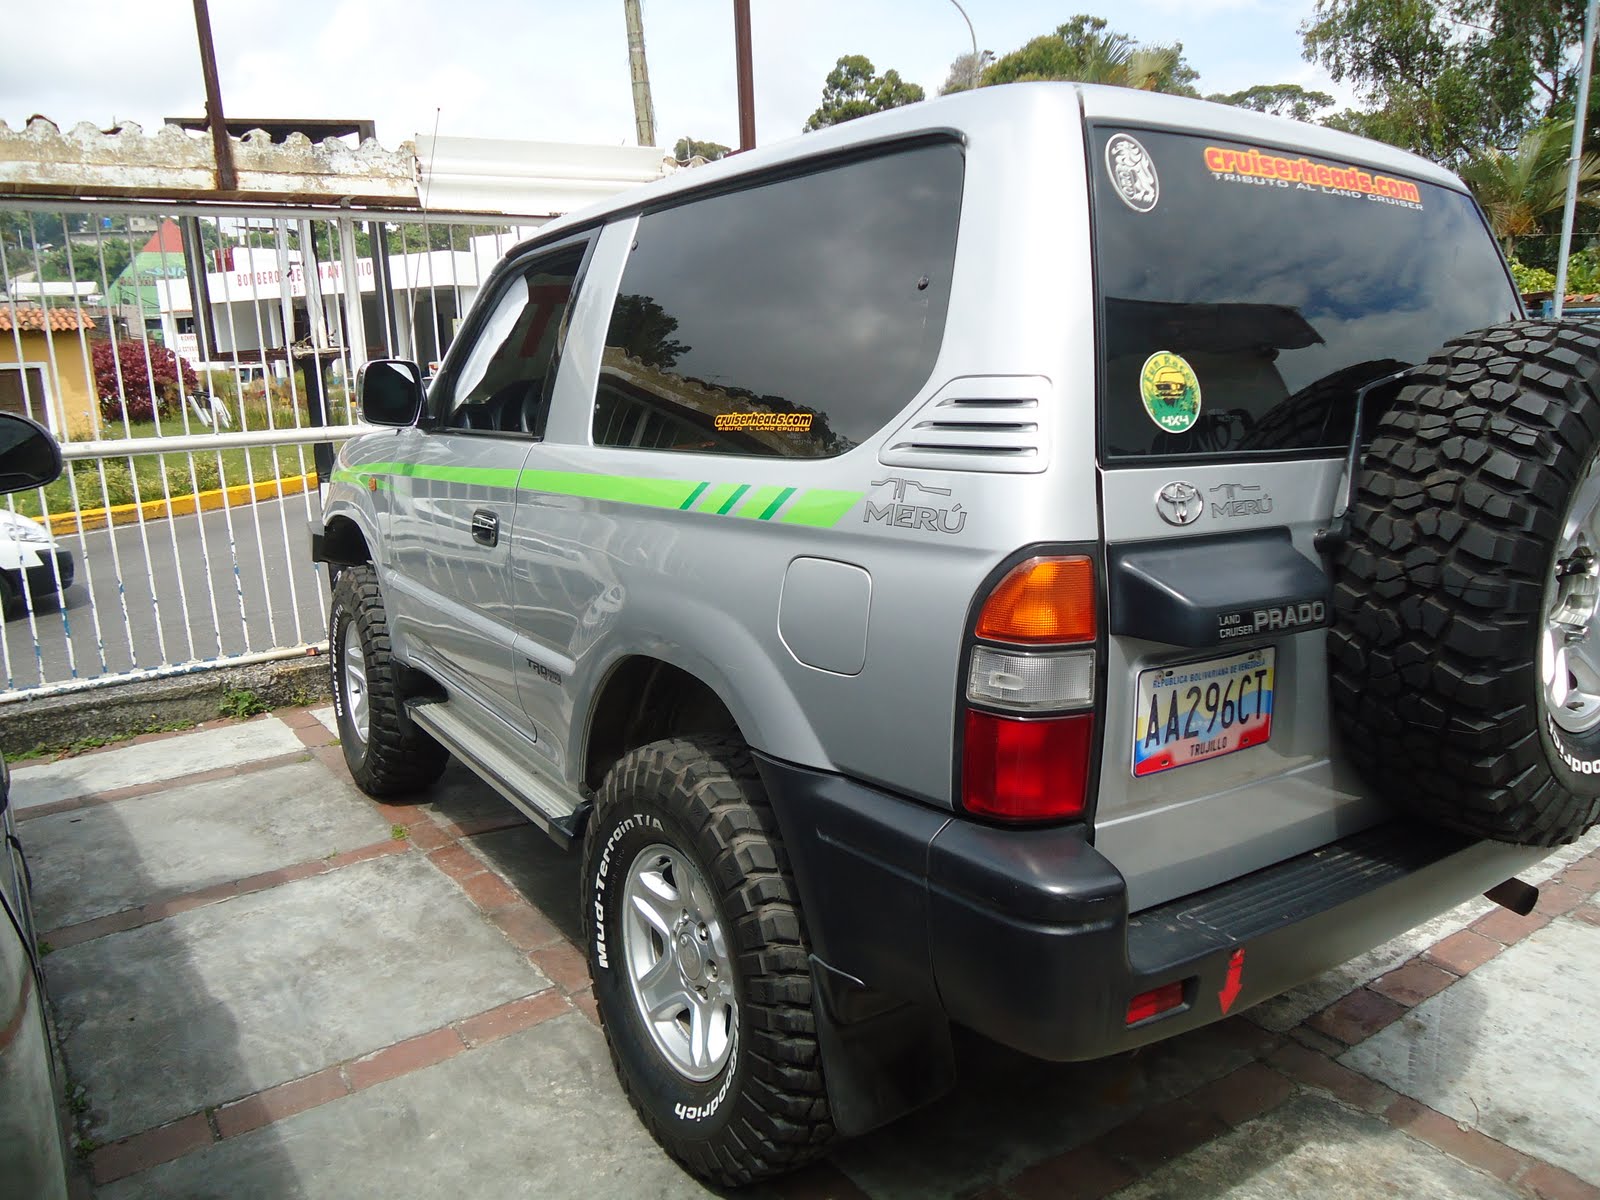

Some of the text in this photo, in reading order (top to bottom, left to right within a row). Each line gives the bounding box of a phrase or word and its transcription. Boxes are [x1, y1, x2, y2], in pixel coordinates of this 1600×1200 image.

[1204, 146, 1420, 203] cruiserheads.com
[1211, 172, 1424, 211] TRIBUTO AL LAND CRUISER
[237, 270, 284, 287] BOMBERO
[714, 412, 813, 427] cruiserheads.com
[1211, 494, 1273, 518] MERÚ
[863, 501, 967, 534] MERÚ
[1219, 614, 1241, 627] LAND
[1253, 601, 1326, 633] PRADO
[1219, 624, 1254, 639] CRUISER
[1230, 664, 1238, 673] DE
[1144, 669, 1268, 749] AA296CT
[1190, 737, 1228, 757] TRUJILLO
